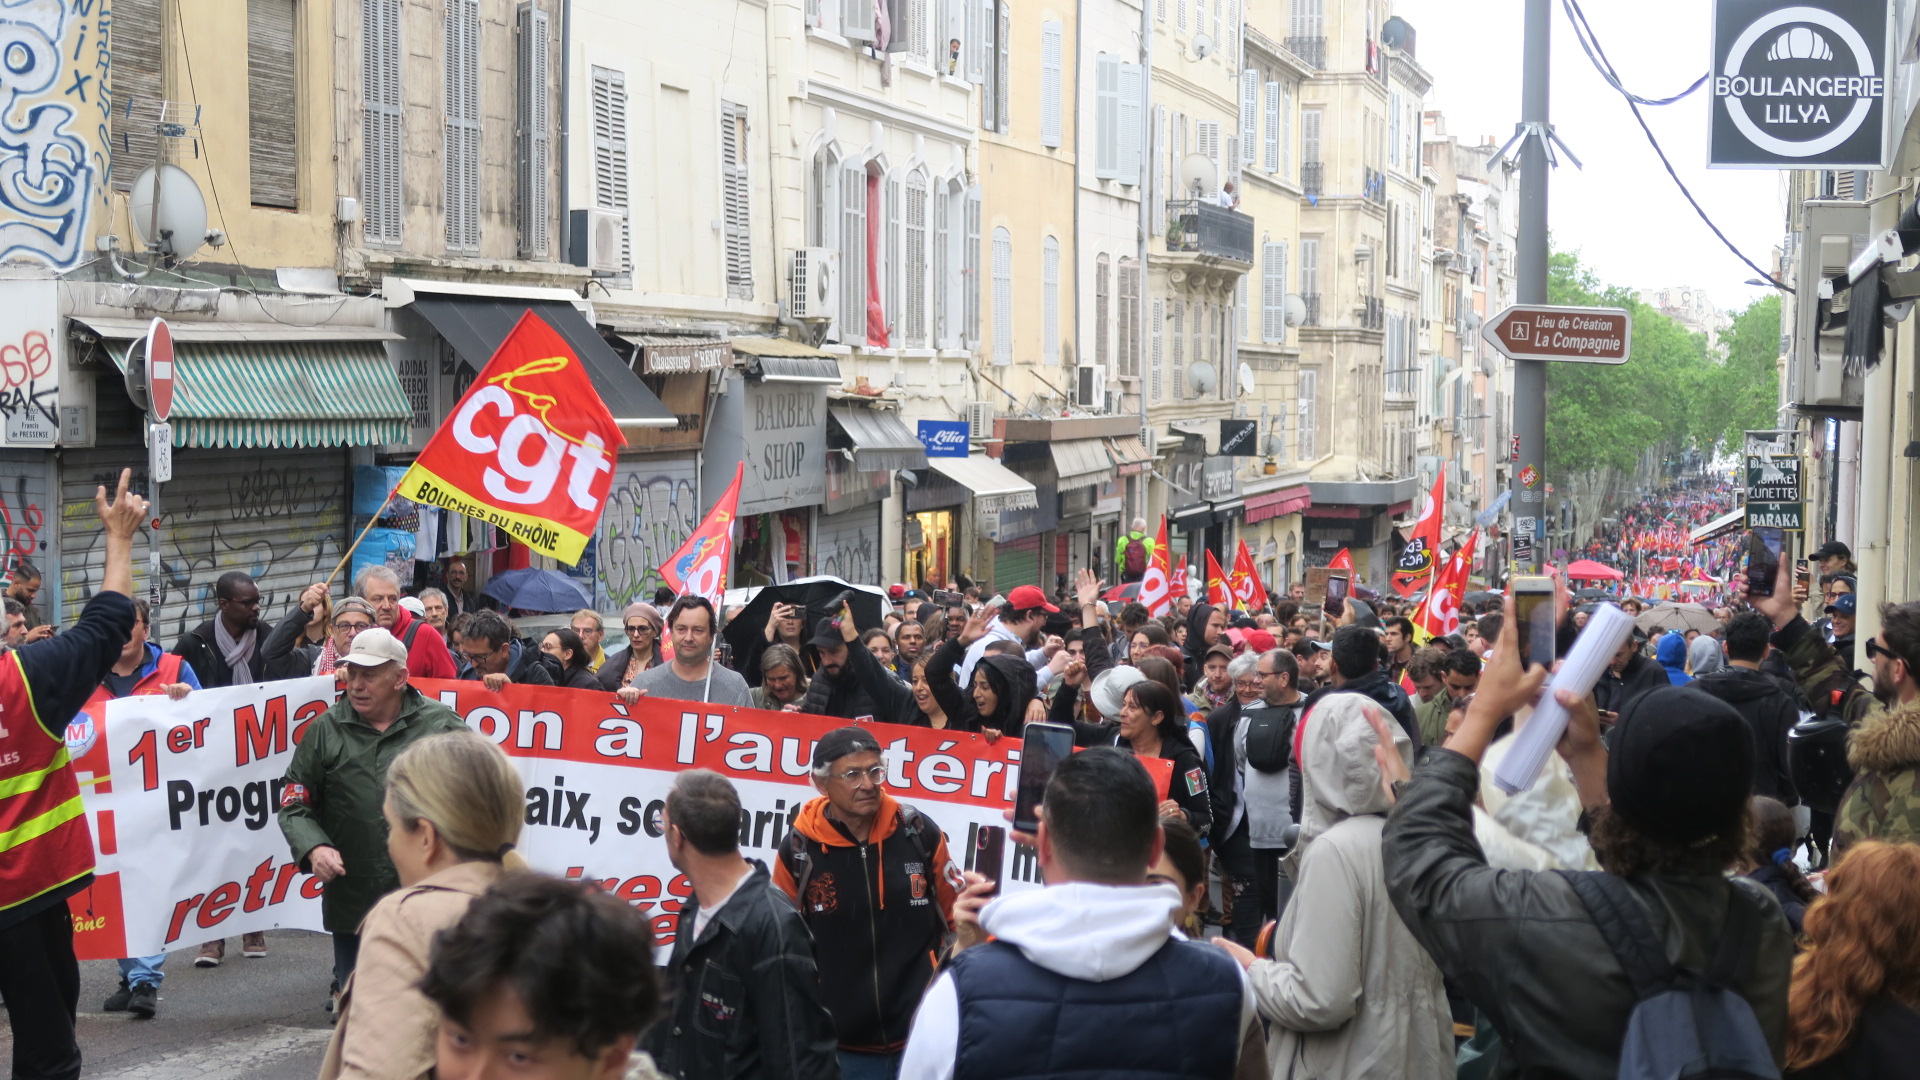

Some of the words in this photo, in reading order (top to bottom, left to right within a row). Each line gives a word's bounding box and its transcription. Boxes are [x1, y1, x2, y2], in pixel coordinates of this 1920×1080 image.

[1715, 76, 1884, 97] BOULANGERIE
[1765, 104, 1831, 124] LILYA
[1535, 315, 1555, 329] Lieu
[1558, 317, 1570, 329] de
[1572, 317, 1613, 332] Création
[1534, 331, 1550, 347] La
[1552, 332, 1621, 354] Compagnie
[398, 360, 428, 376] ADIDAS
[650, 351, 691, 370] Chaussures
[754, 391, 816, 432] BARBER
[12, 430, 18, 438] de
[452, 384, 612, 513] cgt
[763, 441, 805, 482] SHOP
[416, 480, 486, 520] BOUCHES
[488, 513, 510, 529] DU
[512, 522, 560, 552] RHÔNE
[1769, 503, 1781, 511] LA
[1750, 513, 1800, 527] BARAKA
[128, 717, 211, 792] 1er
[418, 690, 564, 750] on
[594, 703, 644, 760] à
[167, 776, 288, 831] Progr
[524, 776, 601, 845] aix,
